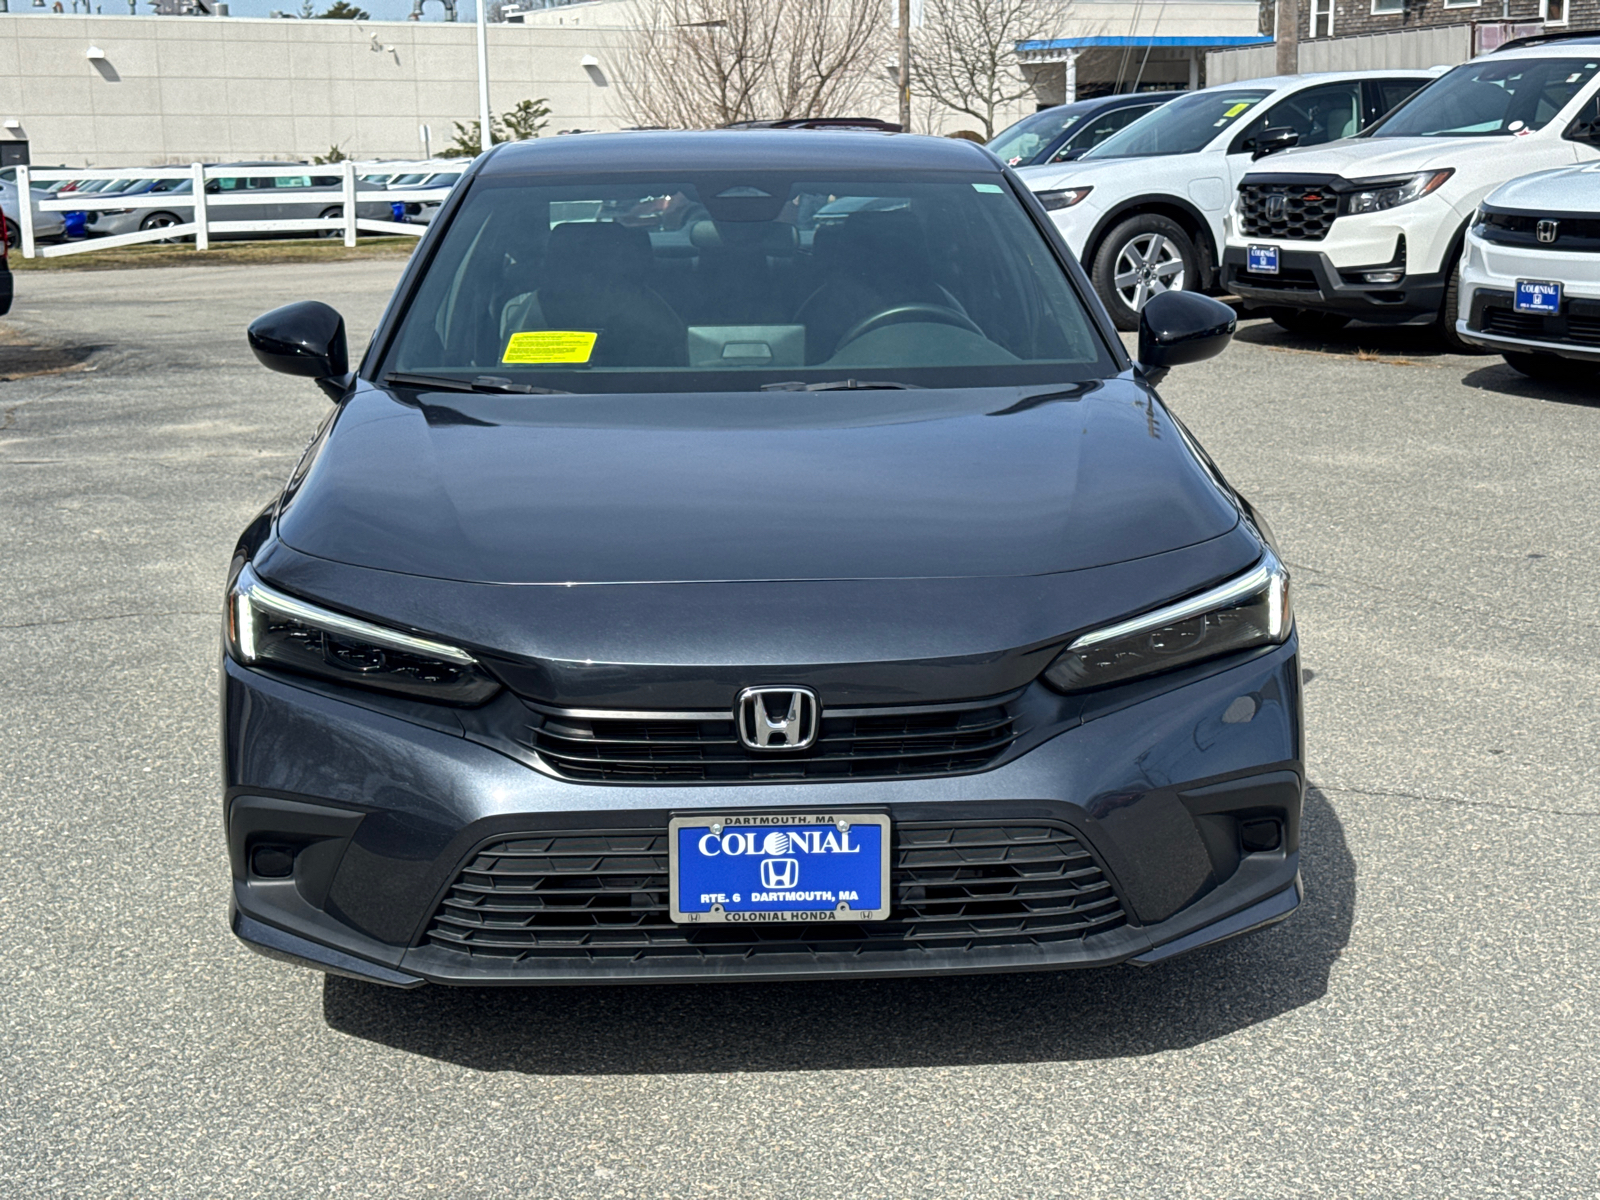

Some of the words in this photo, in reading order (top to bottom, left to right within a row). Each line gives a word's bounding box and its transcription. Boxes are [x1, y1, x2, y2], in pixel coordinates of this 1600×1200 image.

[1521, 284, 1556, 295] COLONIAL
[815, 816, 835, 824] MA
[698, 831, 860, 856] COLONIAL
[701, 893, 730, 903] RTE.
[732, 893, 741, 902] 6
[751, 891, 836, 902] DARTMOUTH,
[839, 891, 859, 901] MA
[725, 912, 787, 922] COLONIAL
[791, 912, 836, 921] HONDA
